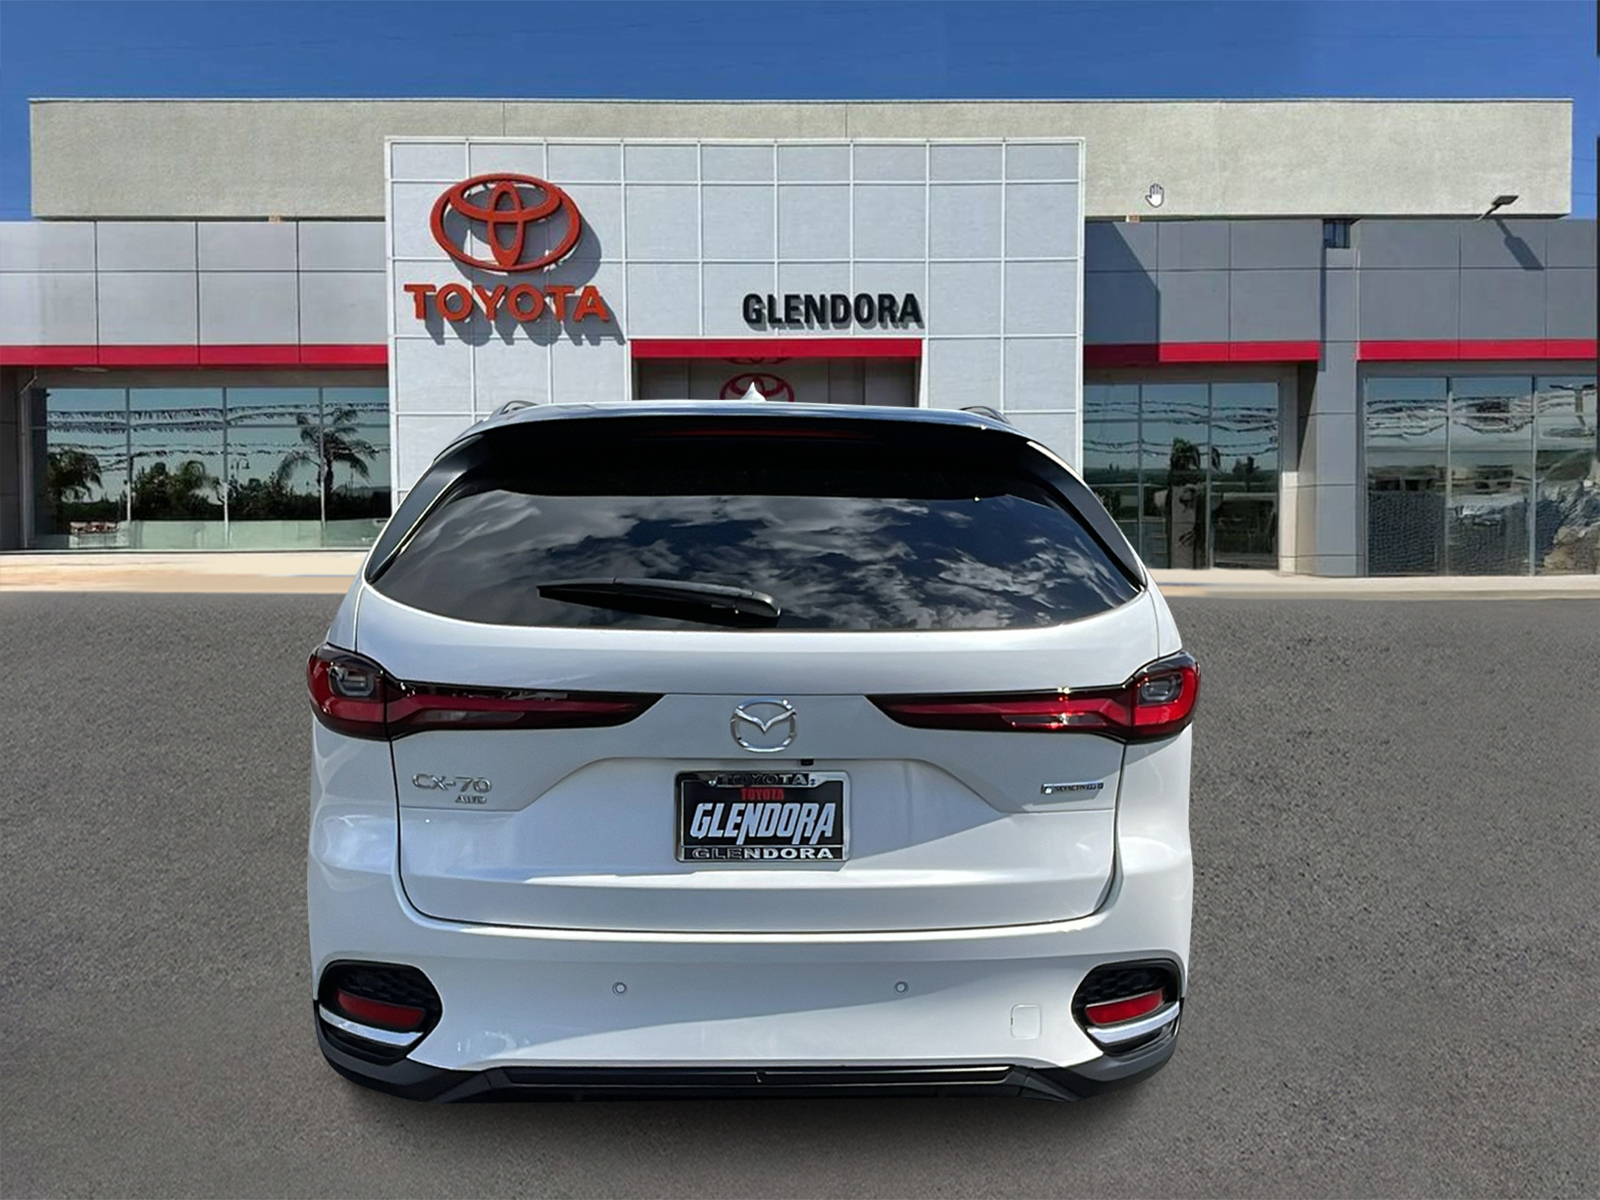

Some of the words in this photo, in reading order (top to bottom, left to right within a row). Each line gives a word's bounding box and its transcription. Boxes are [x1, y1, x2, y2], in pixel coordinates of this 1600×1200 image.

[404, 284, 610, 323] TOYOTA
[743, 292, 923, 325] GLENDORA
[412, 773, 492, 793] CX-70
[717, 773, 808, 786] TOYOTA
[740, 787, 784, 800] TOYOTA
[690, 803, 836, 845] GLENDORA
[692, 848, 834, 859] GLENDORA
